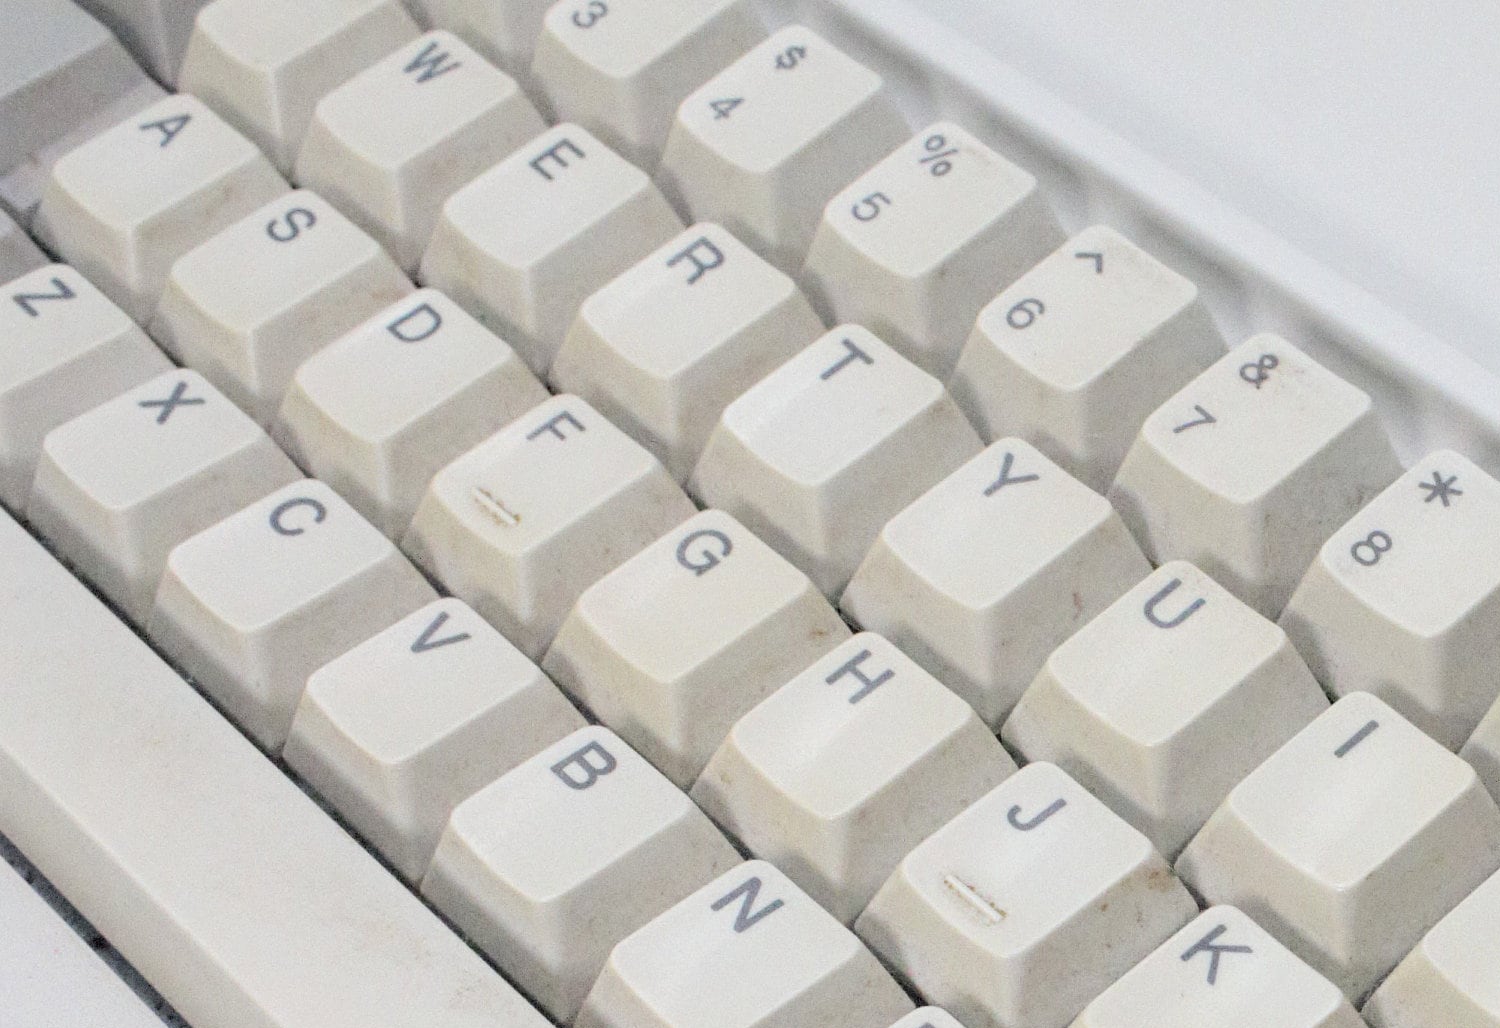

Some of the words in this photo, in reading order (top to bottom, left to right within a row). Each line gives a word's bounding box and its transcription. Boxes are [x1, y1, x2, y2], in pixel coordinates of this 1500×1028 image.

[572, 0, 608, 29] 3
[404, 42, 461, 83] W
[773, 45, 807, 71] $
[710, 98, 743, 119] 4
[141, 114, 191, 147] A
[530, 139, 585, 180] E
[920, 135, 958, 177] %
[267, 209, 316, 242] S
[851, 192, 891, 222] 5
[668, 238, 725, 284] R
[14, 279, 74, 316] Z
[1006, 298, 1045, 330] 6
[389, 304, 442, 342] D
[821, 339, 873, 380] T
[1240, 354, 1279, 388] &
[141, 383, 203, 423] X
[1173, 405, 1216, 434] 7
[527, 411, 586, 443] F
[984, 450, 1036, 496] Y
[269, 497, 327, 536] C
[677, 530, 732, 576] G
[1350, 530, 1392, 566] 8
[1144, 579, 1205, 629] U
[411, 612, 471, 653] V
[827, 651, 893, 702] H
[1335, 721, 1378, 757] I
[552, 742, 616, 789] B
[1008, 800, 1065, 830] J
[713, 878, 783, 931] N
[1180, 924, 1252, 985] K
